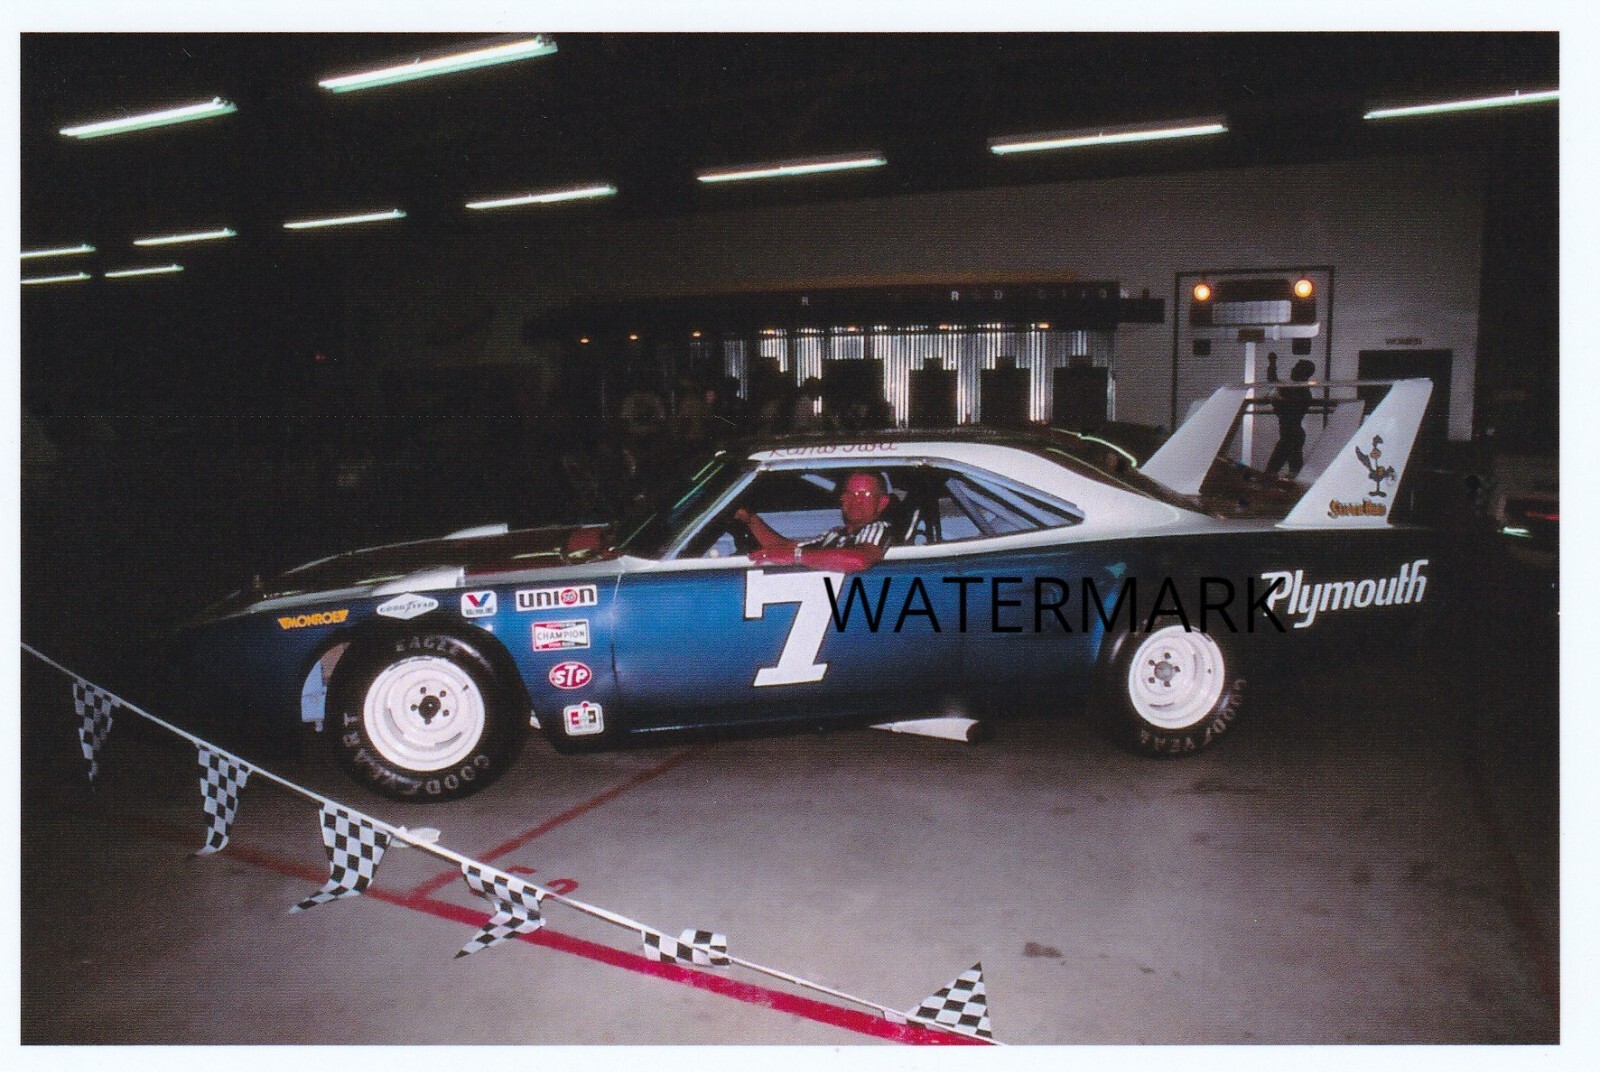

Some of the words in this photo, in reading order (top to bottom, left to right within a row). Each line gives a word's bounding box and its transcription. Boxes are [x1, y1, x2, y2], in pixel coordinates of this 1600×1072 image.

[1261, 559, 1429, 629] Plymouth
[537, 630, 585, 641] CHAMPION
[743, 570, 845, 688] 7
[554, 665, 588, 686] STP
